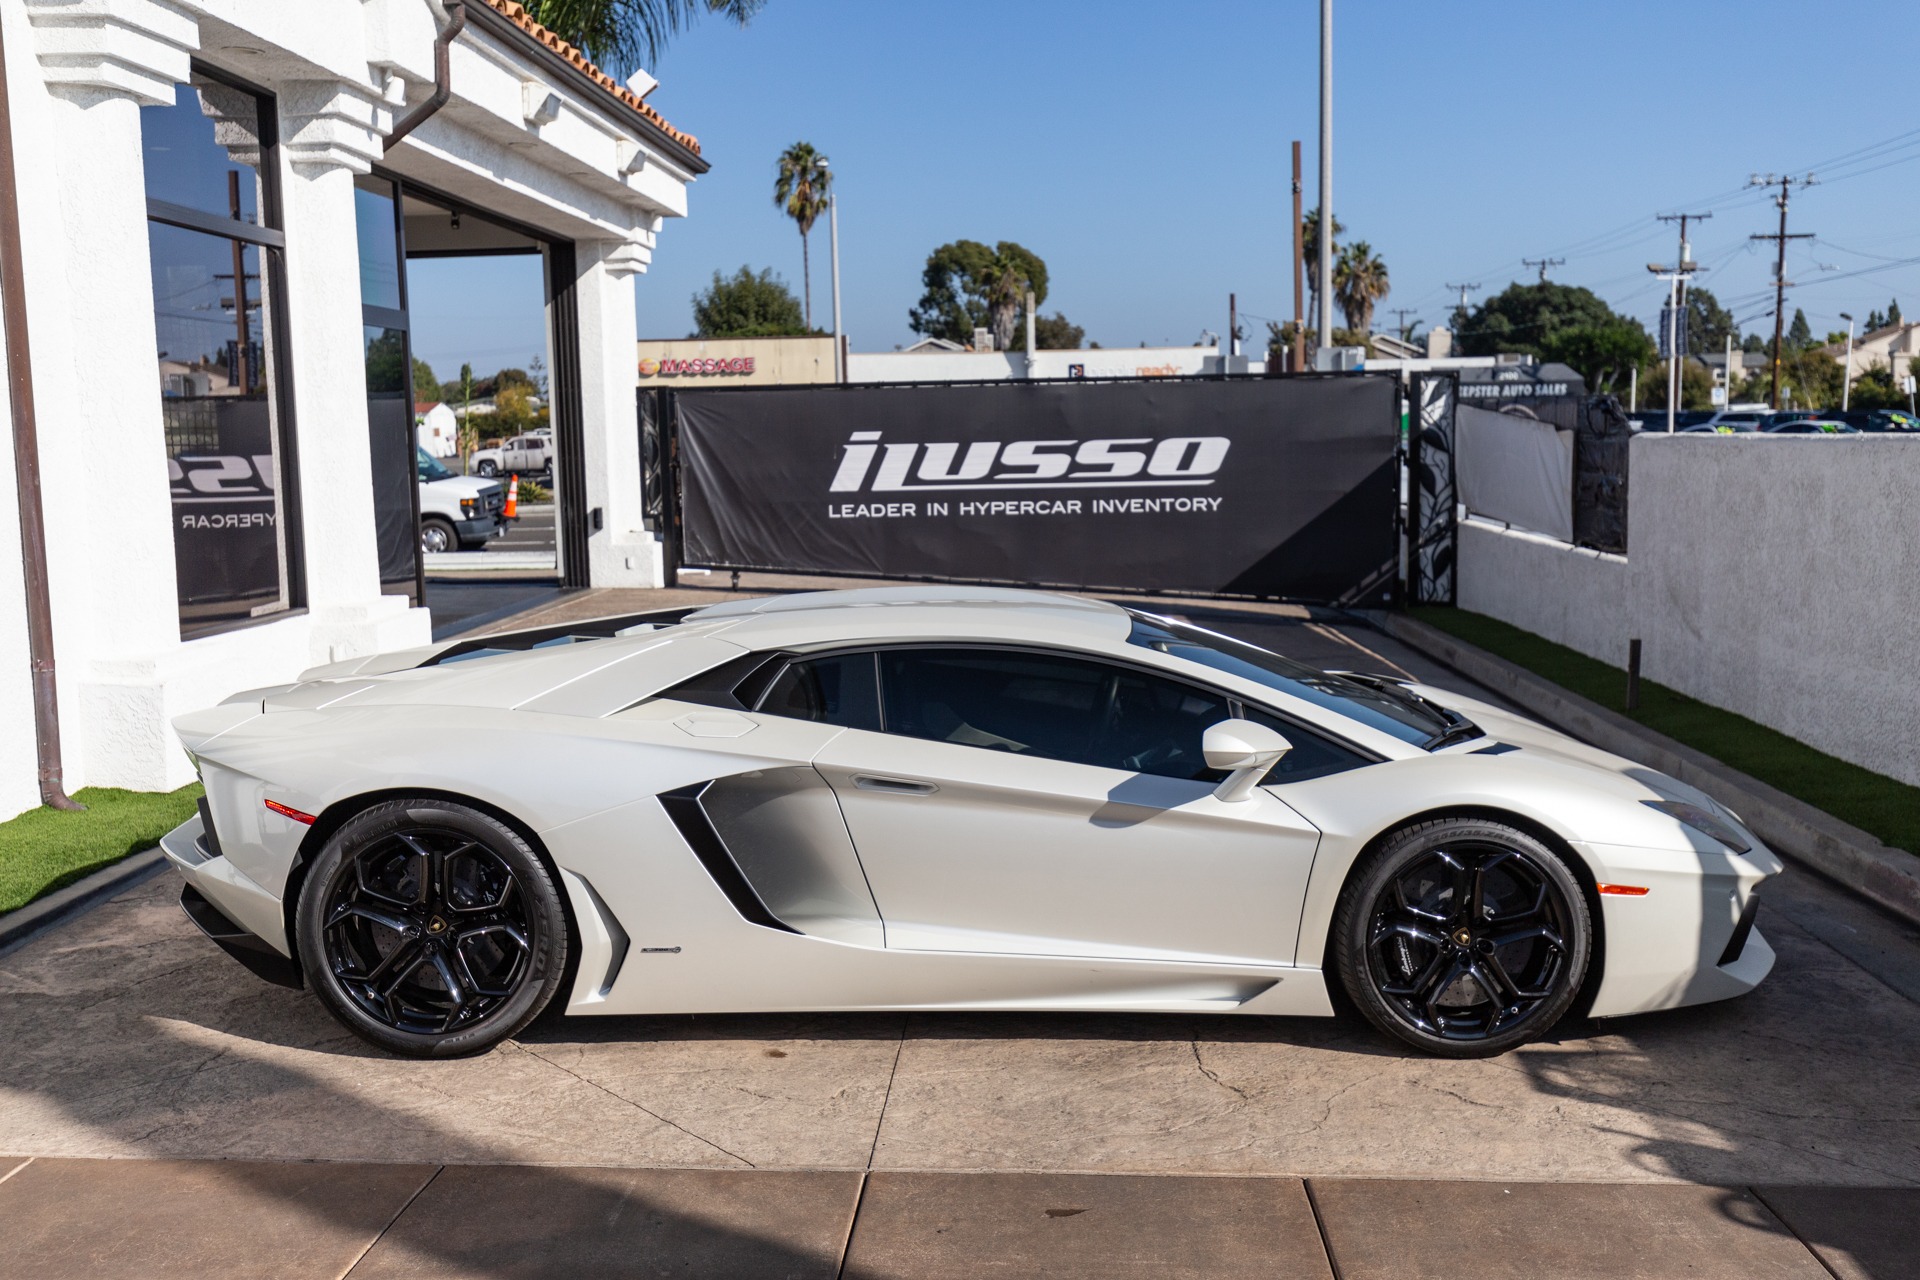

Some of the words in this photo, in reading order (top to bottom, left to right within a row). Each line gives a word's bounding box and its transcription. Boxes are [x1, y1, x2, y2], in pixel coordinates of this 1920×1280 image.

[661, 357, 756, 373] MASSAGE
[1502, 383, 1532, 397] AUTO
[1534, 382, 1567, 396] SALES
[828, 503, 916, 518] LEADER
[926, 502, 948, 516] IN
[959, 499, 1082, 516] HYPERCAR
[1092, 497, 1222, 514] INVENTORY
